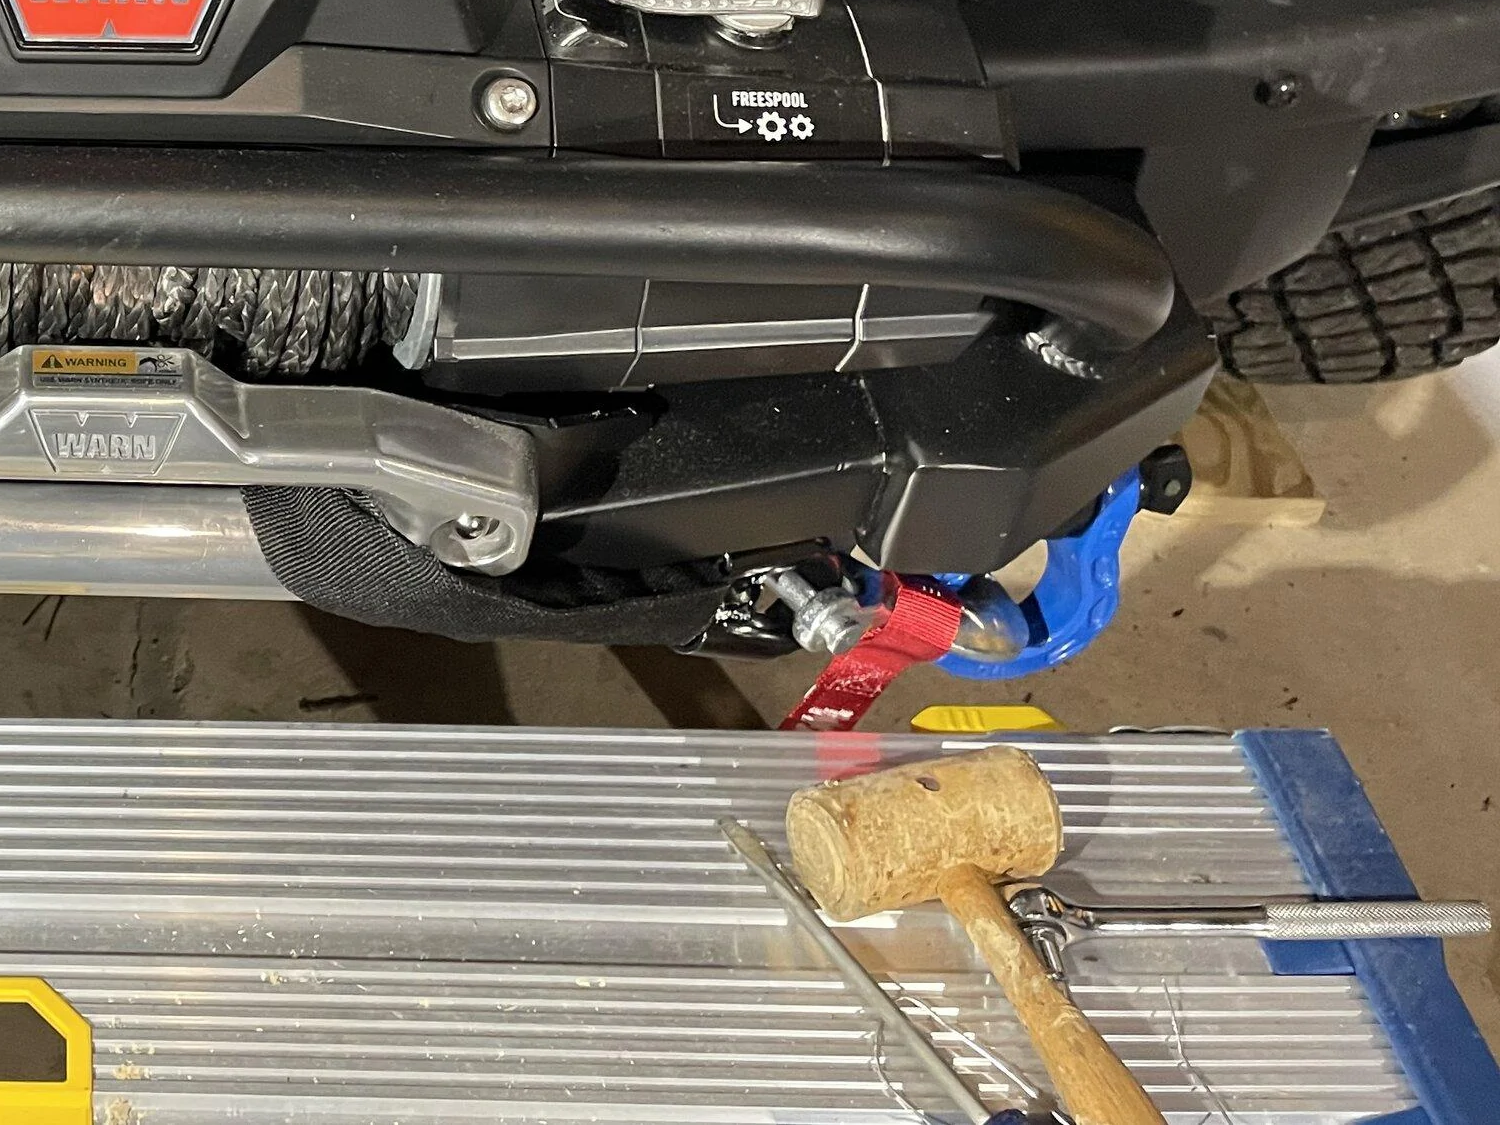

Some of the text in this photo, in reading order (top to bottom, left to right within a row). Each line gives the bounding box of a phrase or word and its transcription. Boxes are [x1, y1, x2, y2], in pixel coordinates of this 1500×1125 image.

[731, 90, 809, 109] FREESPOOL
[65, 357, 127, 367] WARNING
[51, 432, 156, 460] WARN
